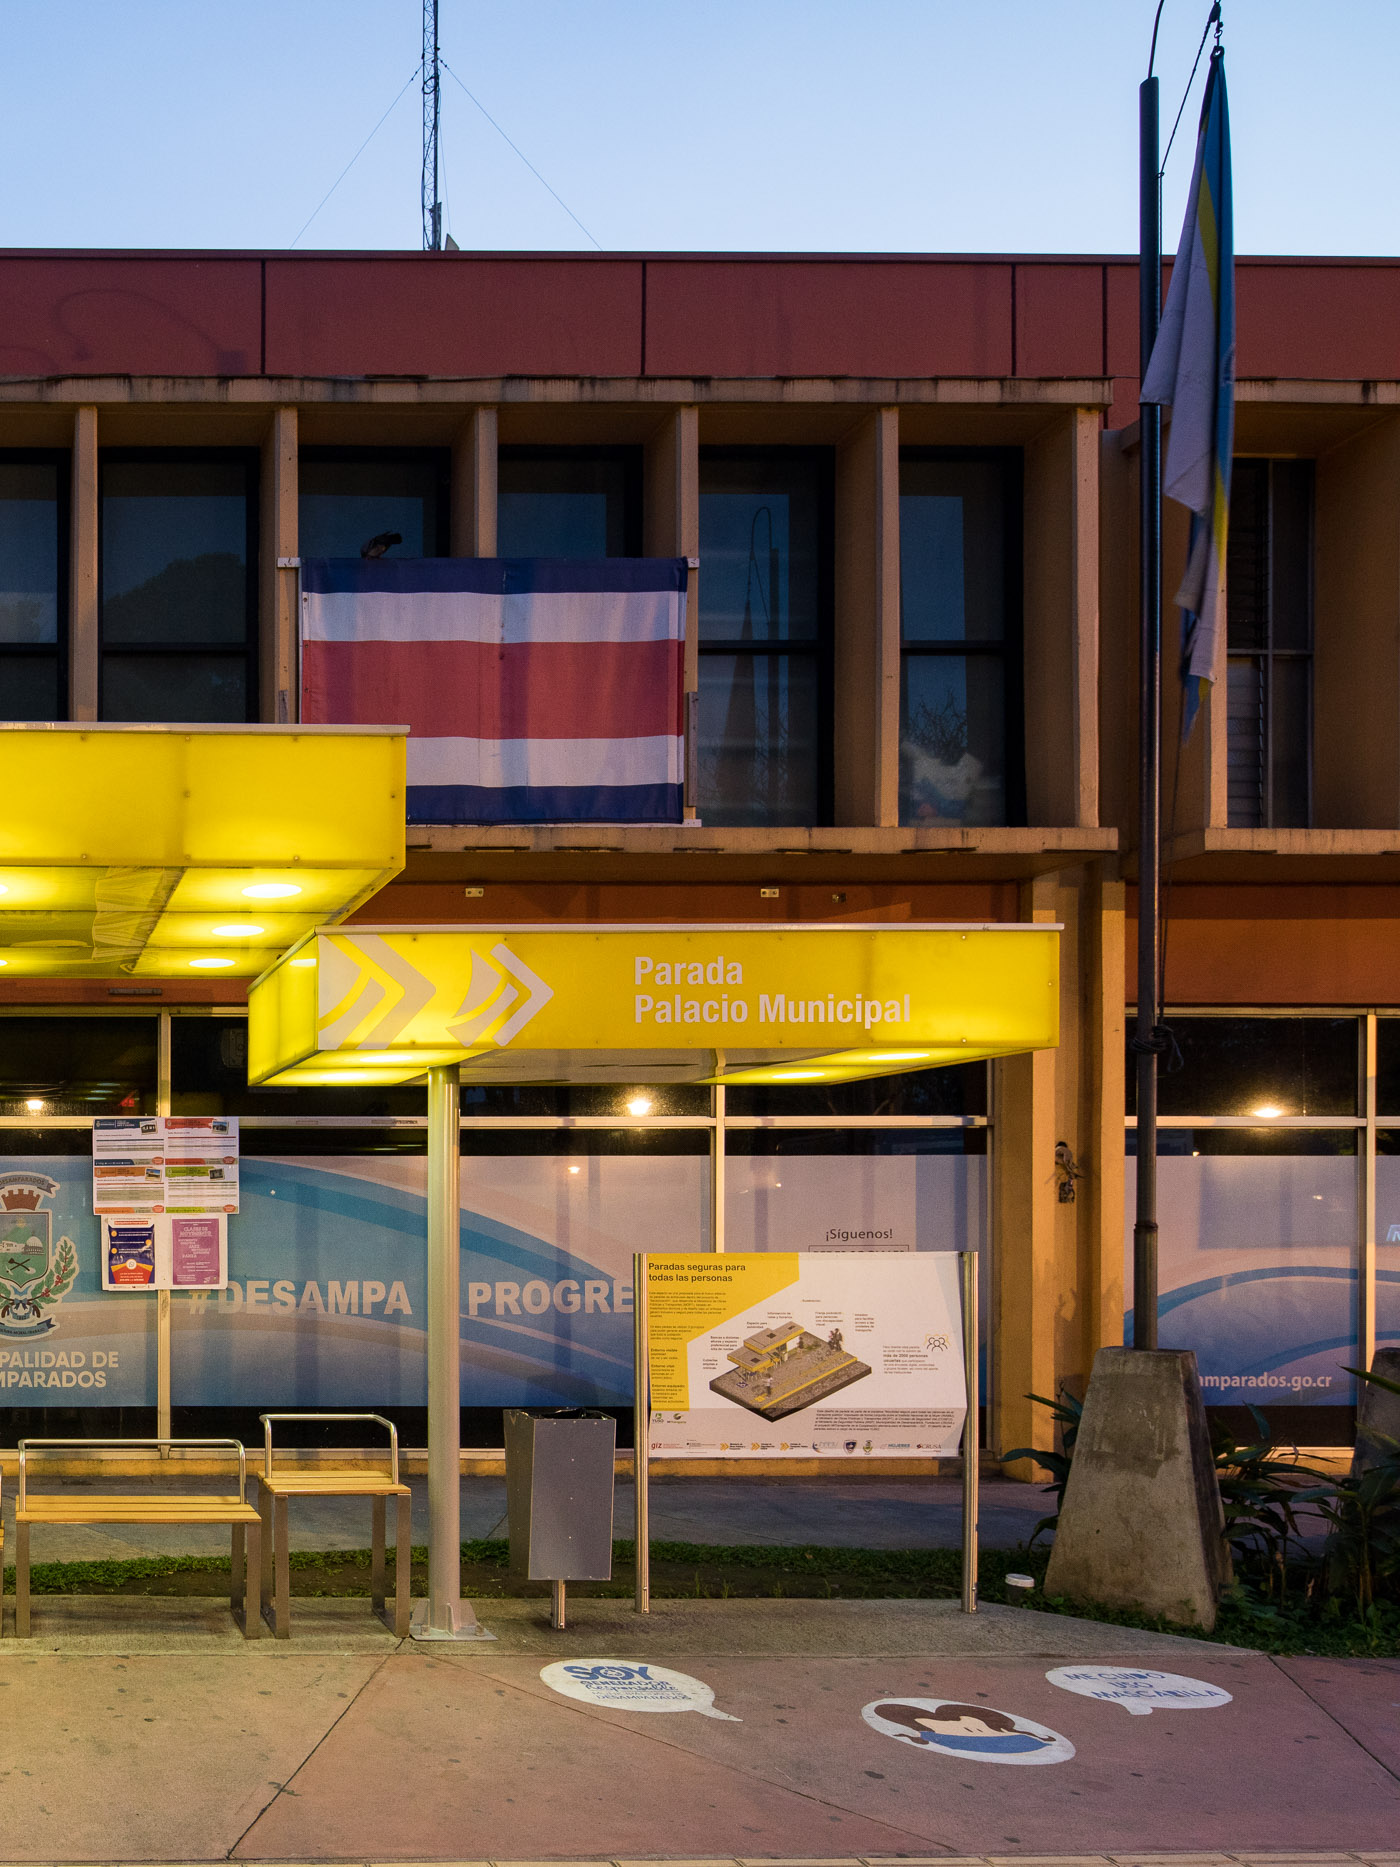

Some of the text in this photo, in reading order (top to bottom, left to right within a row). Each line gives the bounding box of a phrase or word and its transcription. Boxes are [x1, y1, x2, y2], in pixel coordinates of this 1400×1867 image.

[634, 955, 743, 986] Parada
[634, 993, 911, 1030] Palacio Municipal
[825, 1228, 893, 1242] ¡Síguenos!
[648, 1262, 746, 1273] Paradas seguras para
[648, 1273, 733, 1283] todas las personas
[92, 1351, 119, 1368] DE
[651, 1442, 663, 1451] giz
[563, 1665, 655, 1681] SOY
[1063, 1673, 1099, 1681] ME
[1107, 1681, 1154, 1689] USO
